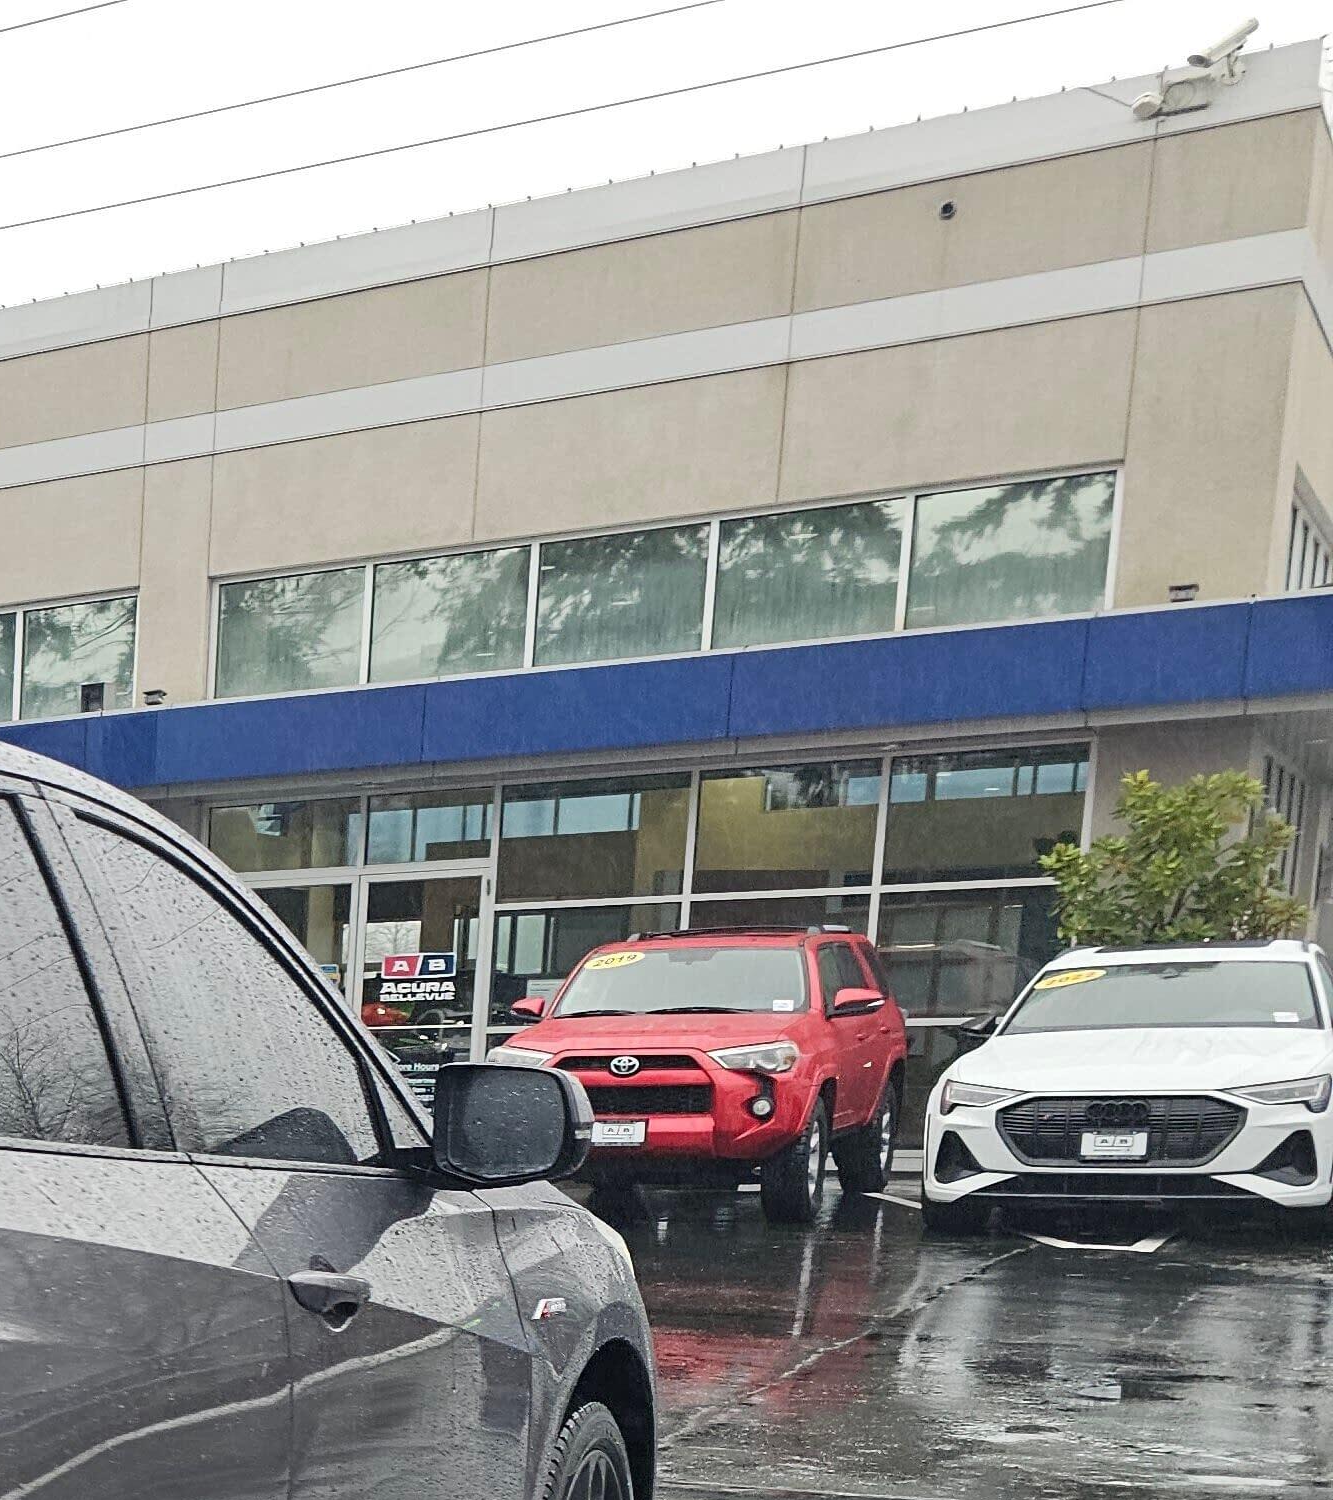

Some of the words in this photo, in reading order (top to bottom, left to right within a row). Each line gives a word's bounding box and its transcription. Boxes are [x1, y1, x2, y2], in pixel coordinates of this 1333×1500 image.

[392, 960, 410, 972] A
[428, 959, 446, 971] B
[380, 982, 456, 993] ACURA
[379, 992, 456, 1002] BELLEVUE
